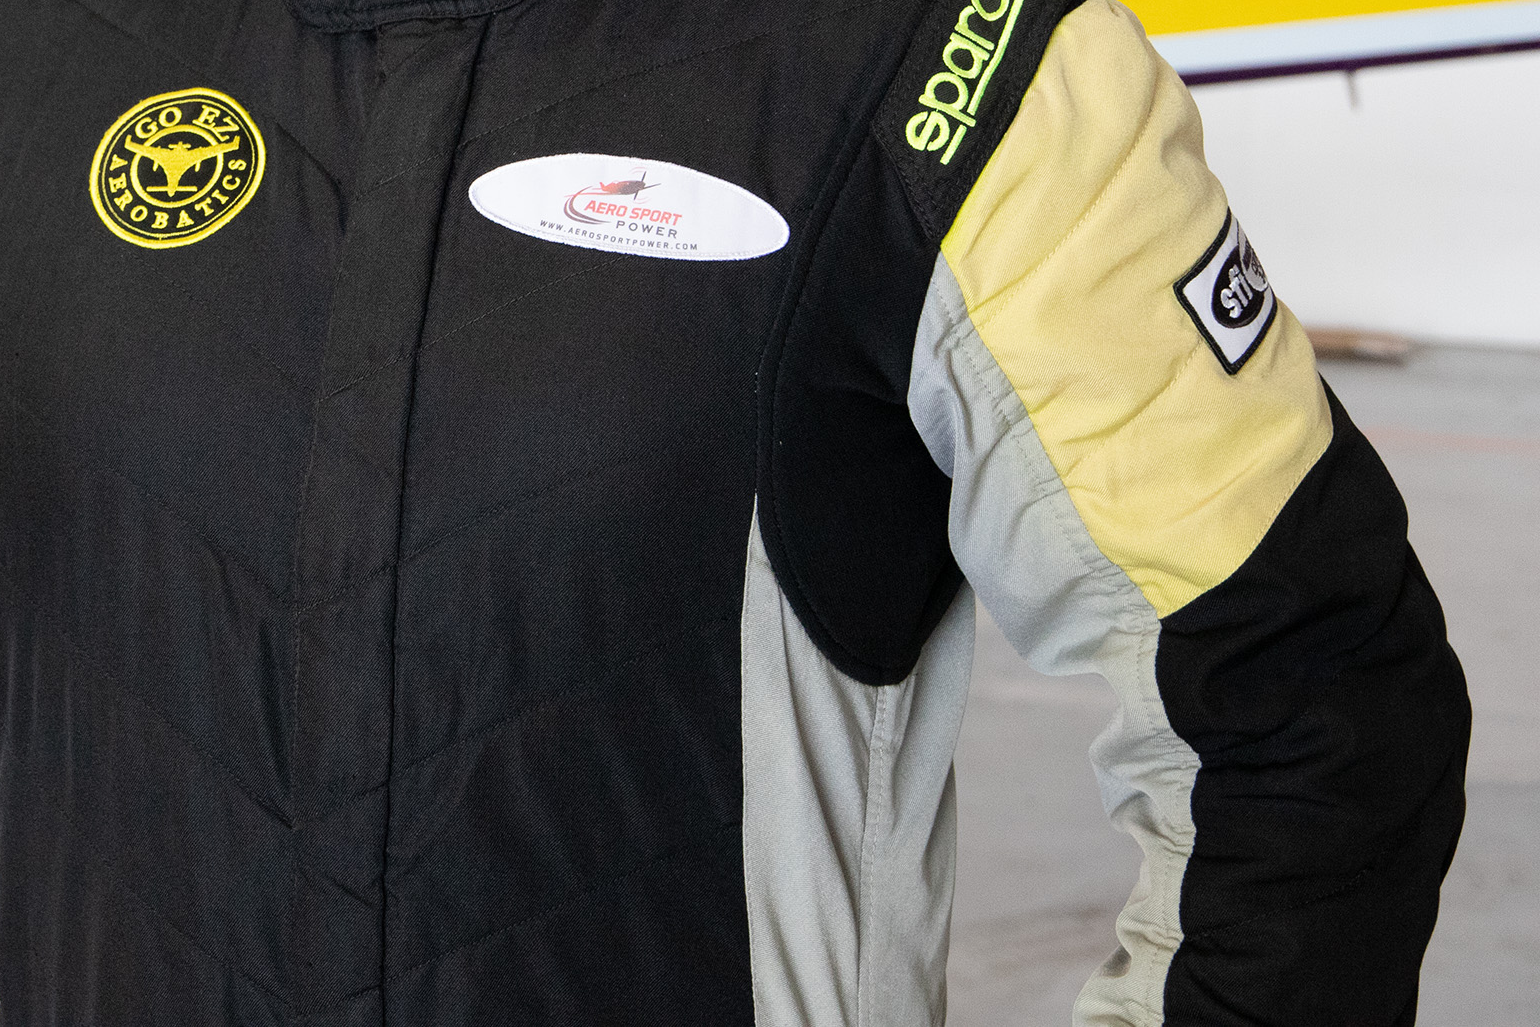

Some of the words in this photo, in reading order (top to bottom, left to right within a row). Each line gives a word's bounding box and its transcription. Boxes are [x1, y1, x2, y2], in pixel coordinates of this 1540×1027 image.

[134, 106, 183, 140] GO
[192, 104, 240, 142] EZ
[108, 154, 247, 230] AEROBATICS
[584, 199, 628, 218] AERO
[629, 207, 683, 226] SPORT
[539, 219, 699, 251] WWW.AEROSPORTPOWER.COM
[615, 220, 678, 240] POWER
